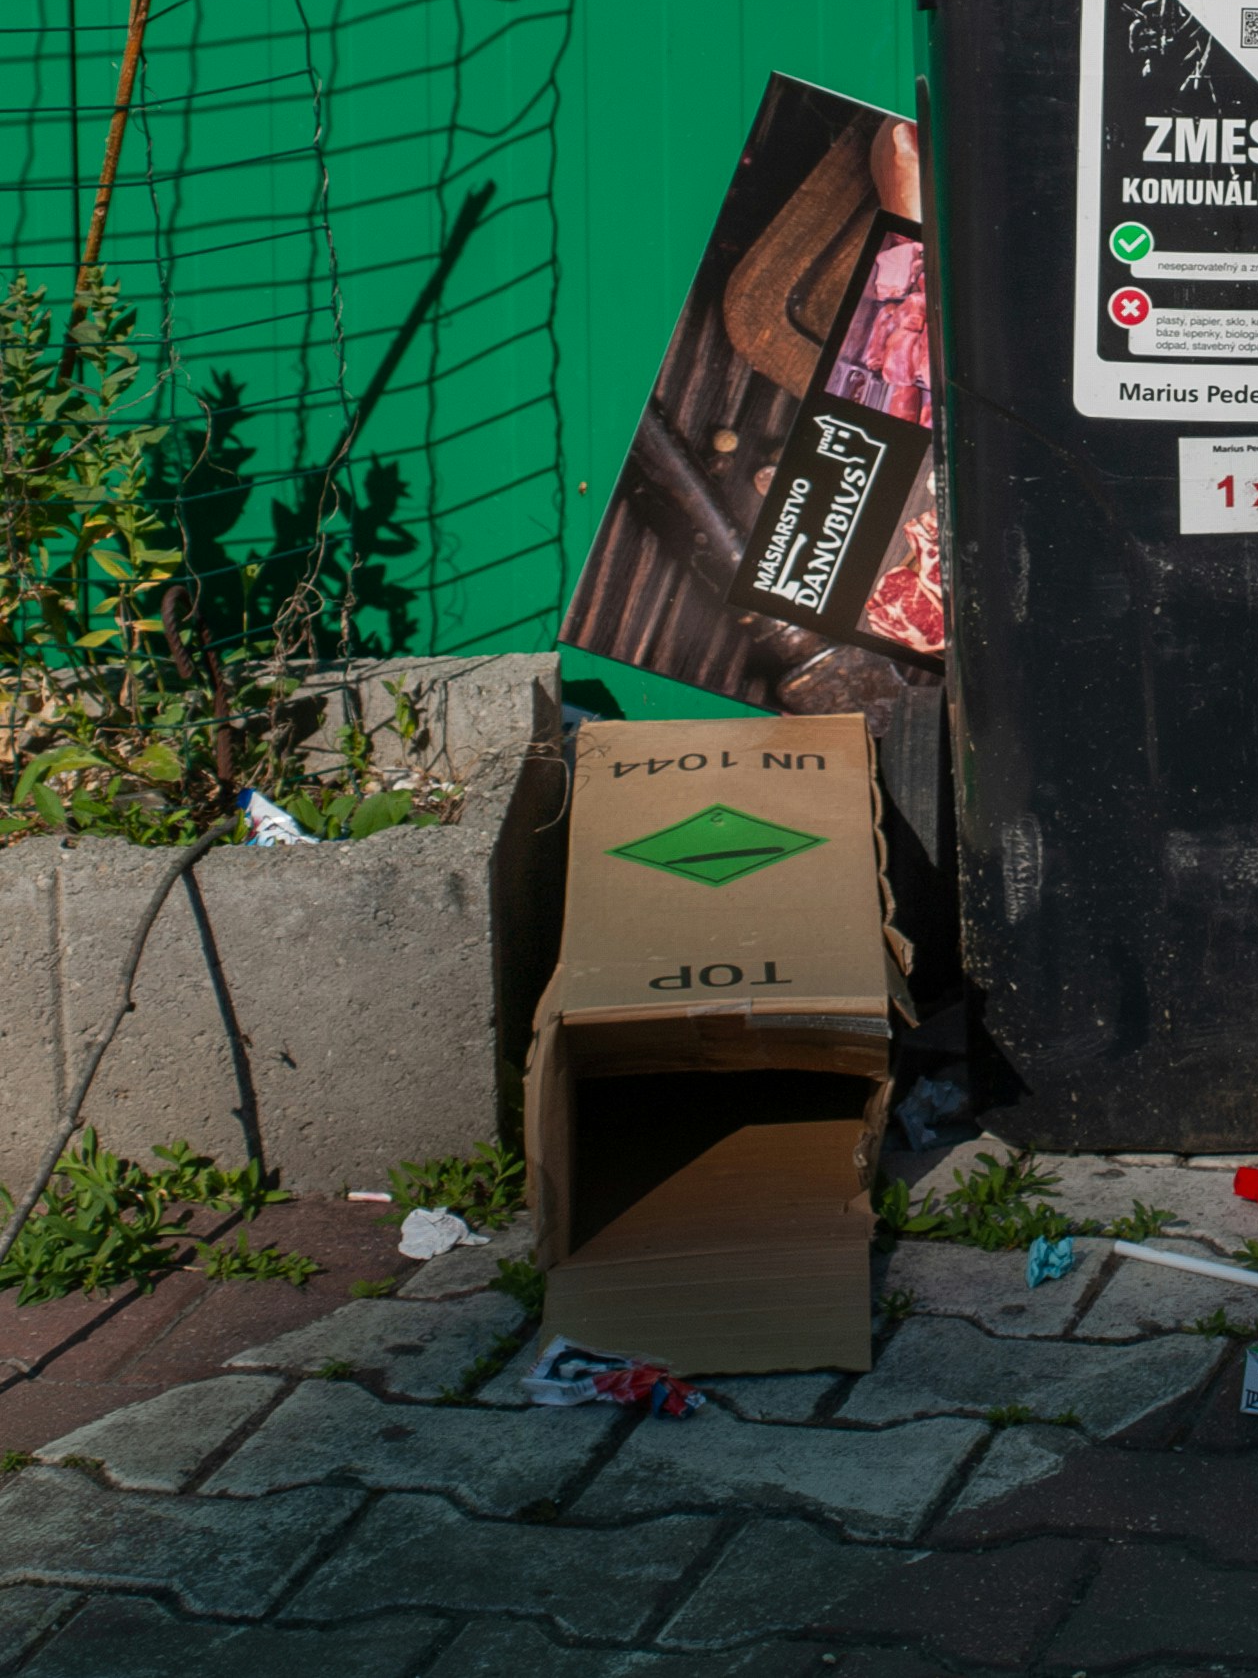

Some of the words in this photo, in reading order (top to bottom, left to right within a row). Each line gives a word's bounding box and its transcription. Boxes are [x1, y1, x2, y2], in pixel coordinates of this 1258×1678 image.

[1241, 264, 1248, 272] a
[1156, 315, 1187, 327] plasty,
[1190, 316, 1223, 328] papier,
[1226, 316, 1249, 327] sklo,
[1156, 328, 1180, 338] báze
[1183, 328, 1223, 340] lepenky,
[1156, 341, 1189, 352] odpad,
[1192, 341, 1235, 353] stavebný
[1119, 382, 1199, 403] Marius
[1212, 443, 1244, 453] Marius
[1216, 475, 1235, 508] 1
[753, 478, 811, 592] MÄSIARSTVO
[608, 751, 738, 778] 1044
[762, 752, 826, 770] UN
[710, 812, 724, 823] 2
[648, 961, 793, 990] TOP
